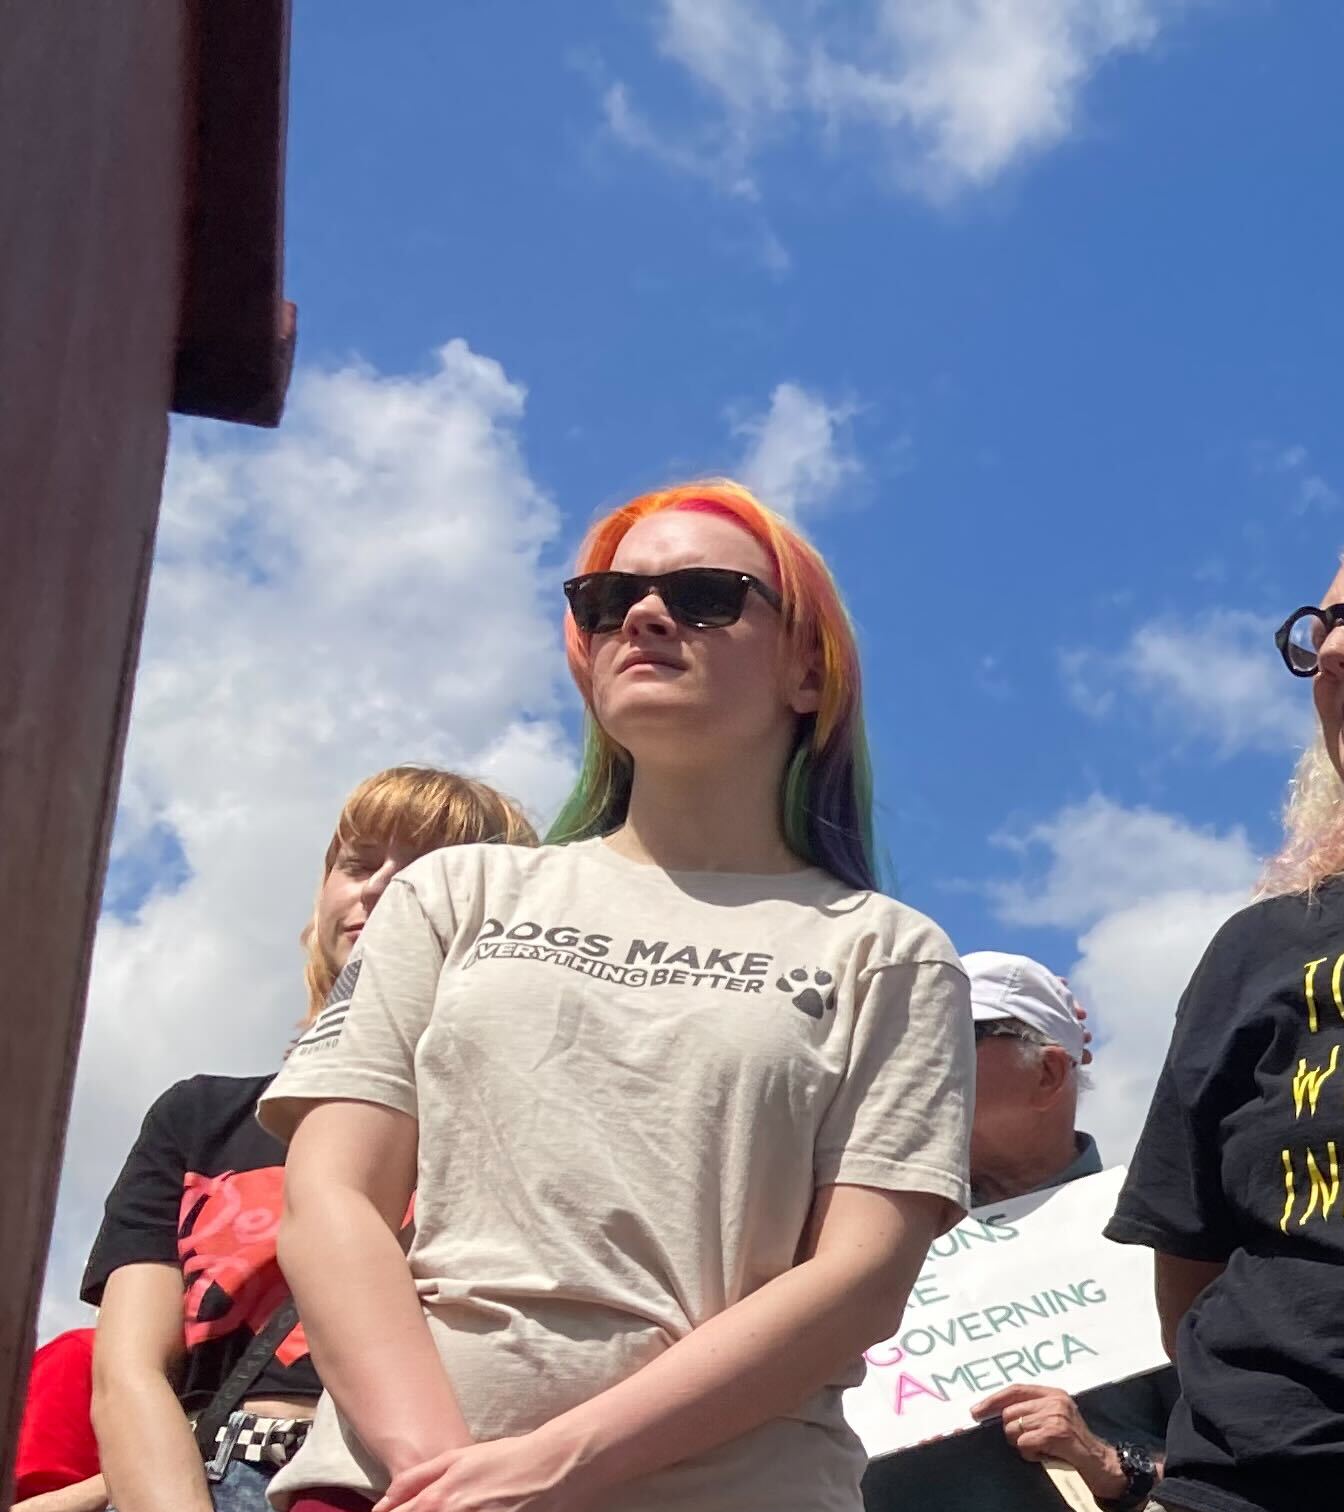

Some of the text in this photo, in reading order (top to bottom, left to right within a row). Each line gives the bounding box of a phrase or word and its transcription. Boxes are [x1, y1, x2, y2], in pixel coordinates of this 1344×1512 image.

[476, 918, 774, 976] DOGS MAKE
[650, 969, 765, 993] BETTER
[926, 1213, 1020, 1262] ONS
[894, 1332, 1099, 1415] AMERICA
